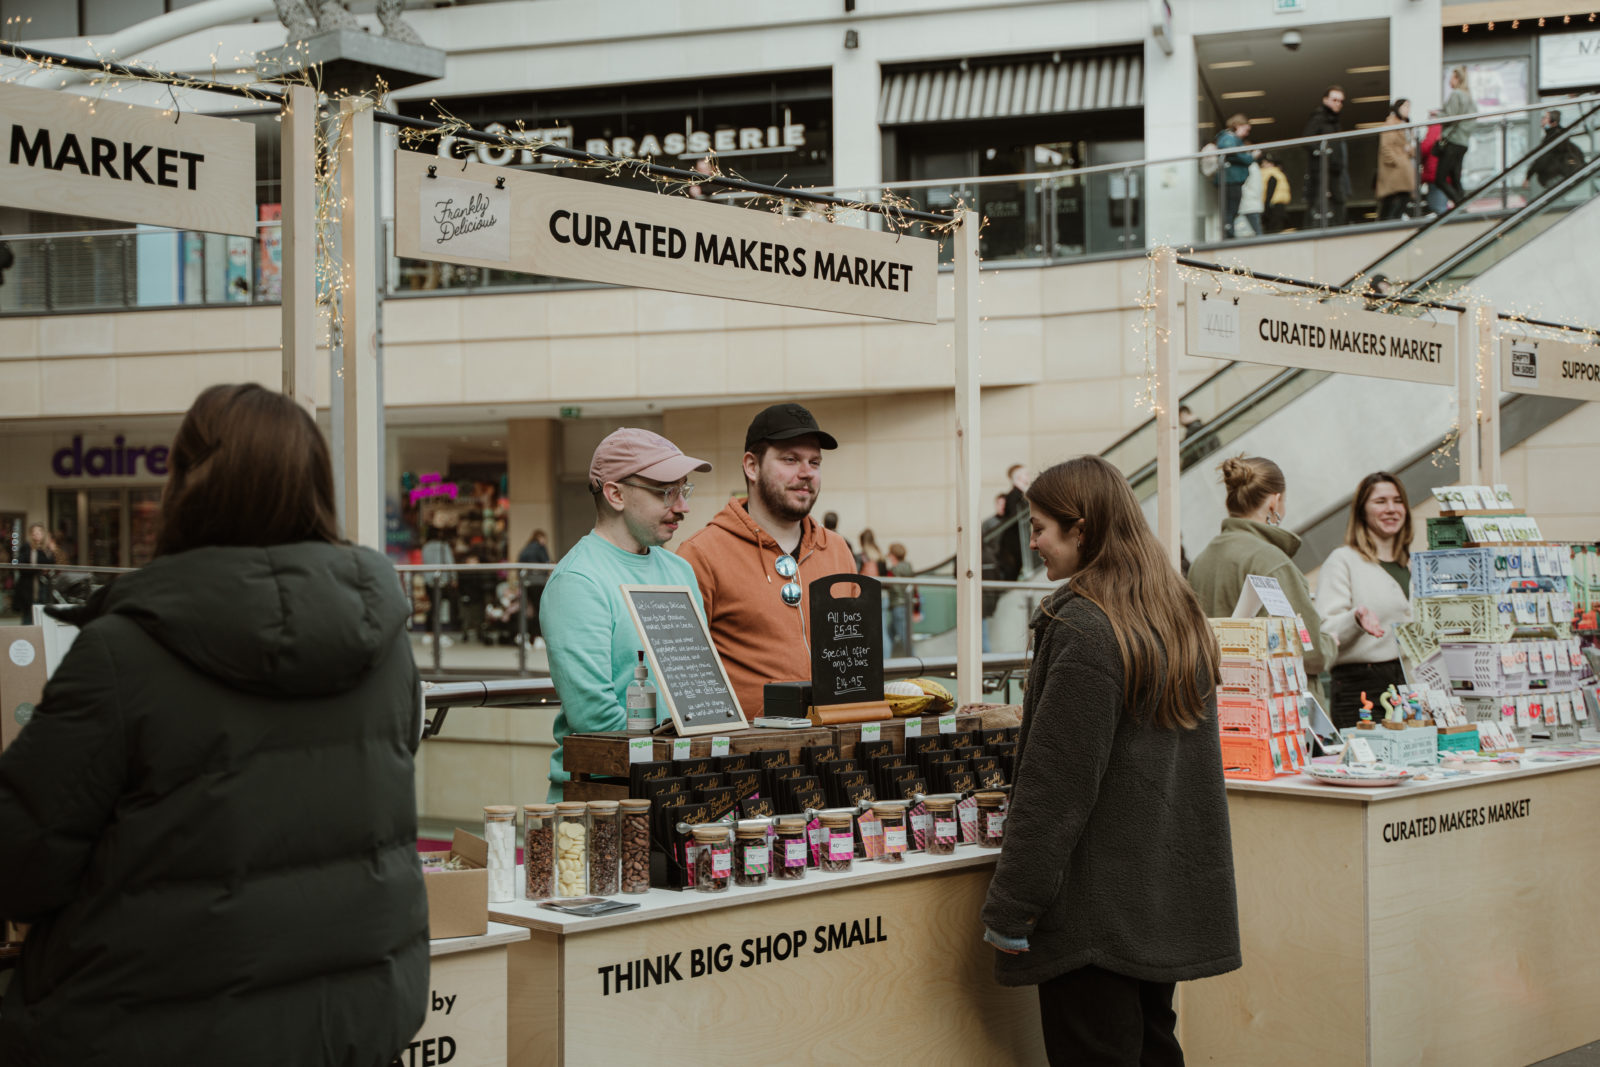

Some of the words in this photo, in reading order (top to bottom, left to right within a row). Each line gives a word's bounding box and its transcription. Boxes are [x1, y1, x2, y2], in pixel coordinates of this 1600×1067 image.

[585, 123, 806, 158] BRASSERIE
[10, 124, 205, 191] MARKET
[434, 193, 490, 223] Frankly
[437, 215, 497, 244] Delicious
[549, 209, 687, 260] CURATED
[694, 231, 807, 277] MAKERS
[813, 250, 913, 292] MARKET
[1259, 318, 1326, 348] CURATED
[1329, 328, 1387, 356] MAKERS
[1390, 336, 1442, 363] MARKET
[827, 611, 839, 623] All
[843, 611, 862, 623] bars
[821, 645, 849, 661] Special
[852, 646, 871, 658] offer
[832, 660, 847, 674] any
[847, 657, 853, 667] 3
[854, 658, 869, 667] bars
[631, 740, 652, 749] vegan
[862, 725, 880, 734] vegan
[1383, 816, 1436, 843] CURATED
[1439, 807, 1486, 833] MAKERS
[1488, 798, 1531, 824] MARKET
[598, 952, 684, 996] THINK
[690, 943, 733, 979] BIG
[740, 930, 807, 968] SHOP
[813, 915, 888, 954] SMALL
[432, 990, 457, 1015] by
[388, 1036, 457, 1067] TED
